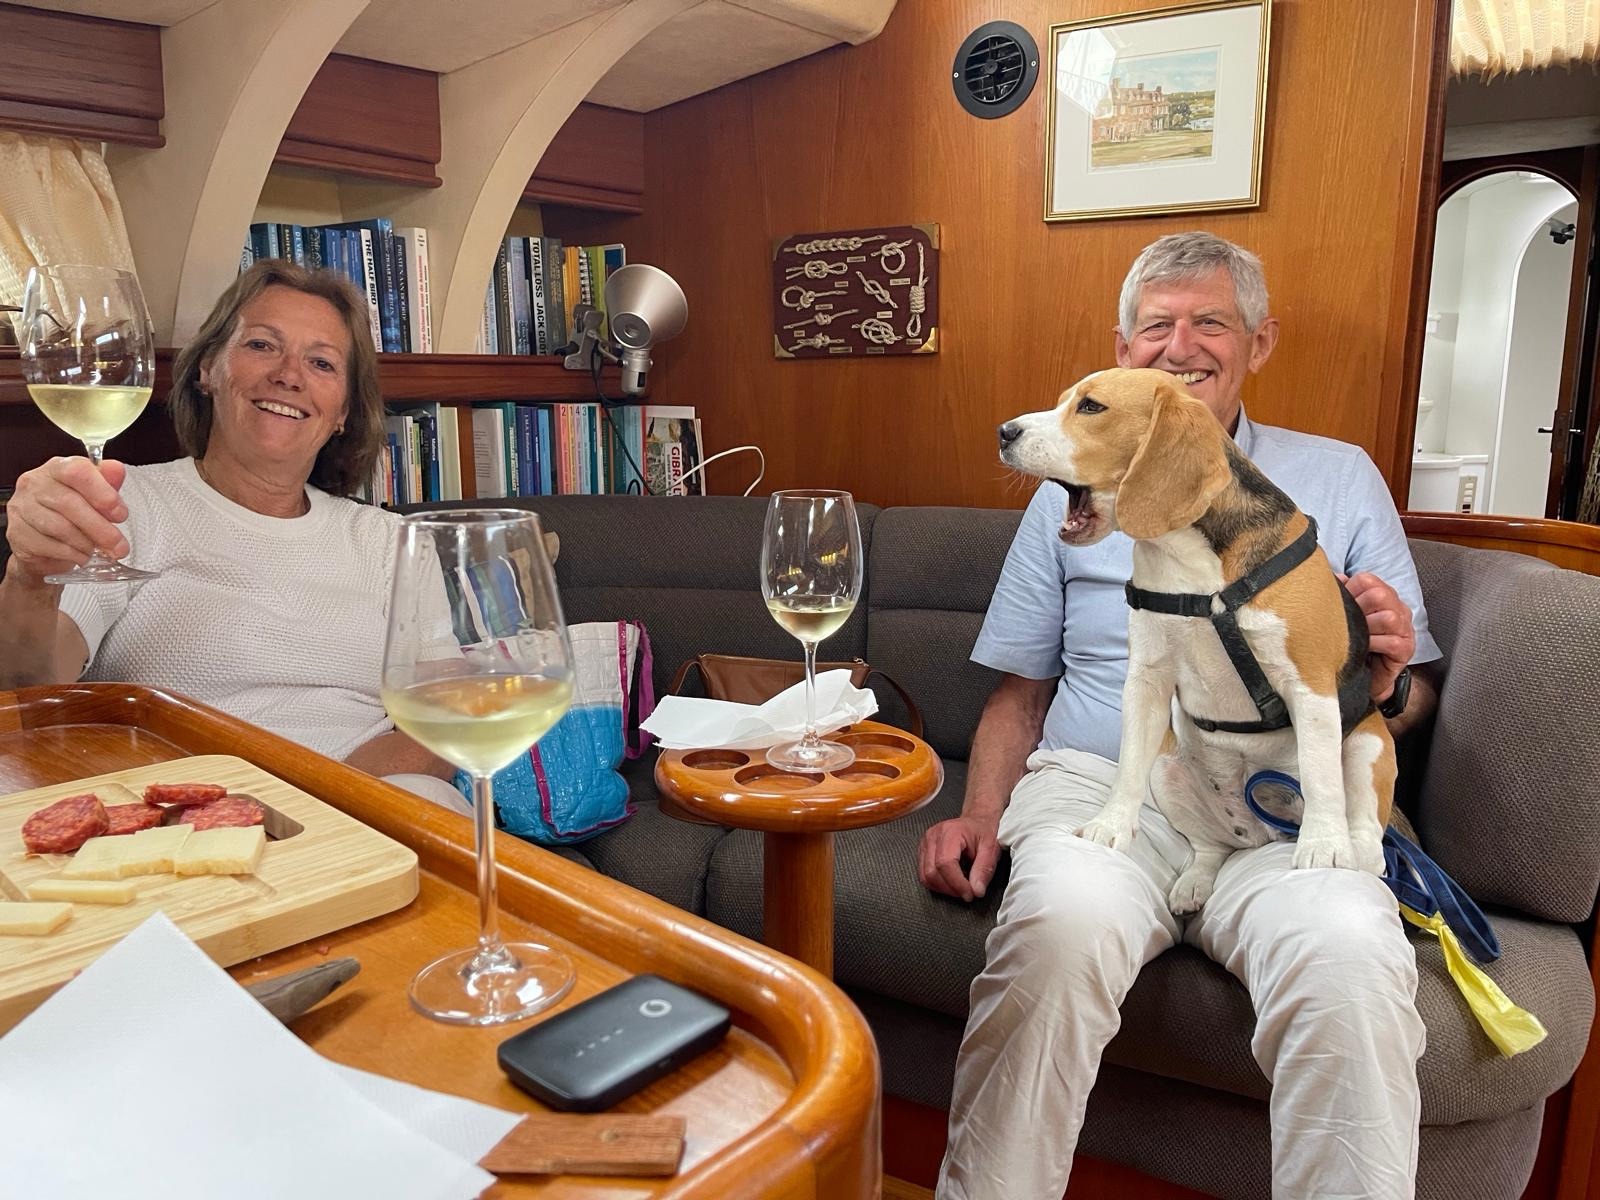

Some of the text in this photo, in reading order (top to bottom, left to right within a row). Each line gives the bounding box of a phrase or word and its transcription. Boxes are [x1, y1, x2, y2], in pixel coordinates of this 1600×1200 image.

[396, 244, 404, 275] PIRATEN
[532, 240, 540, 270] TOTAL
[365, 238, 378, 305] THE HALF BIRD
[534, 272, 543, 298] LOSS
[536, 302, 545, 328] JACK
